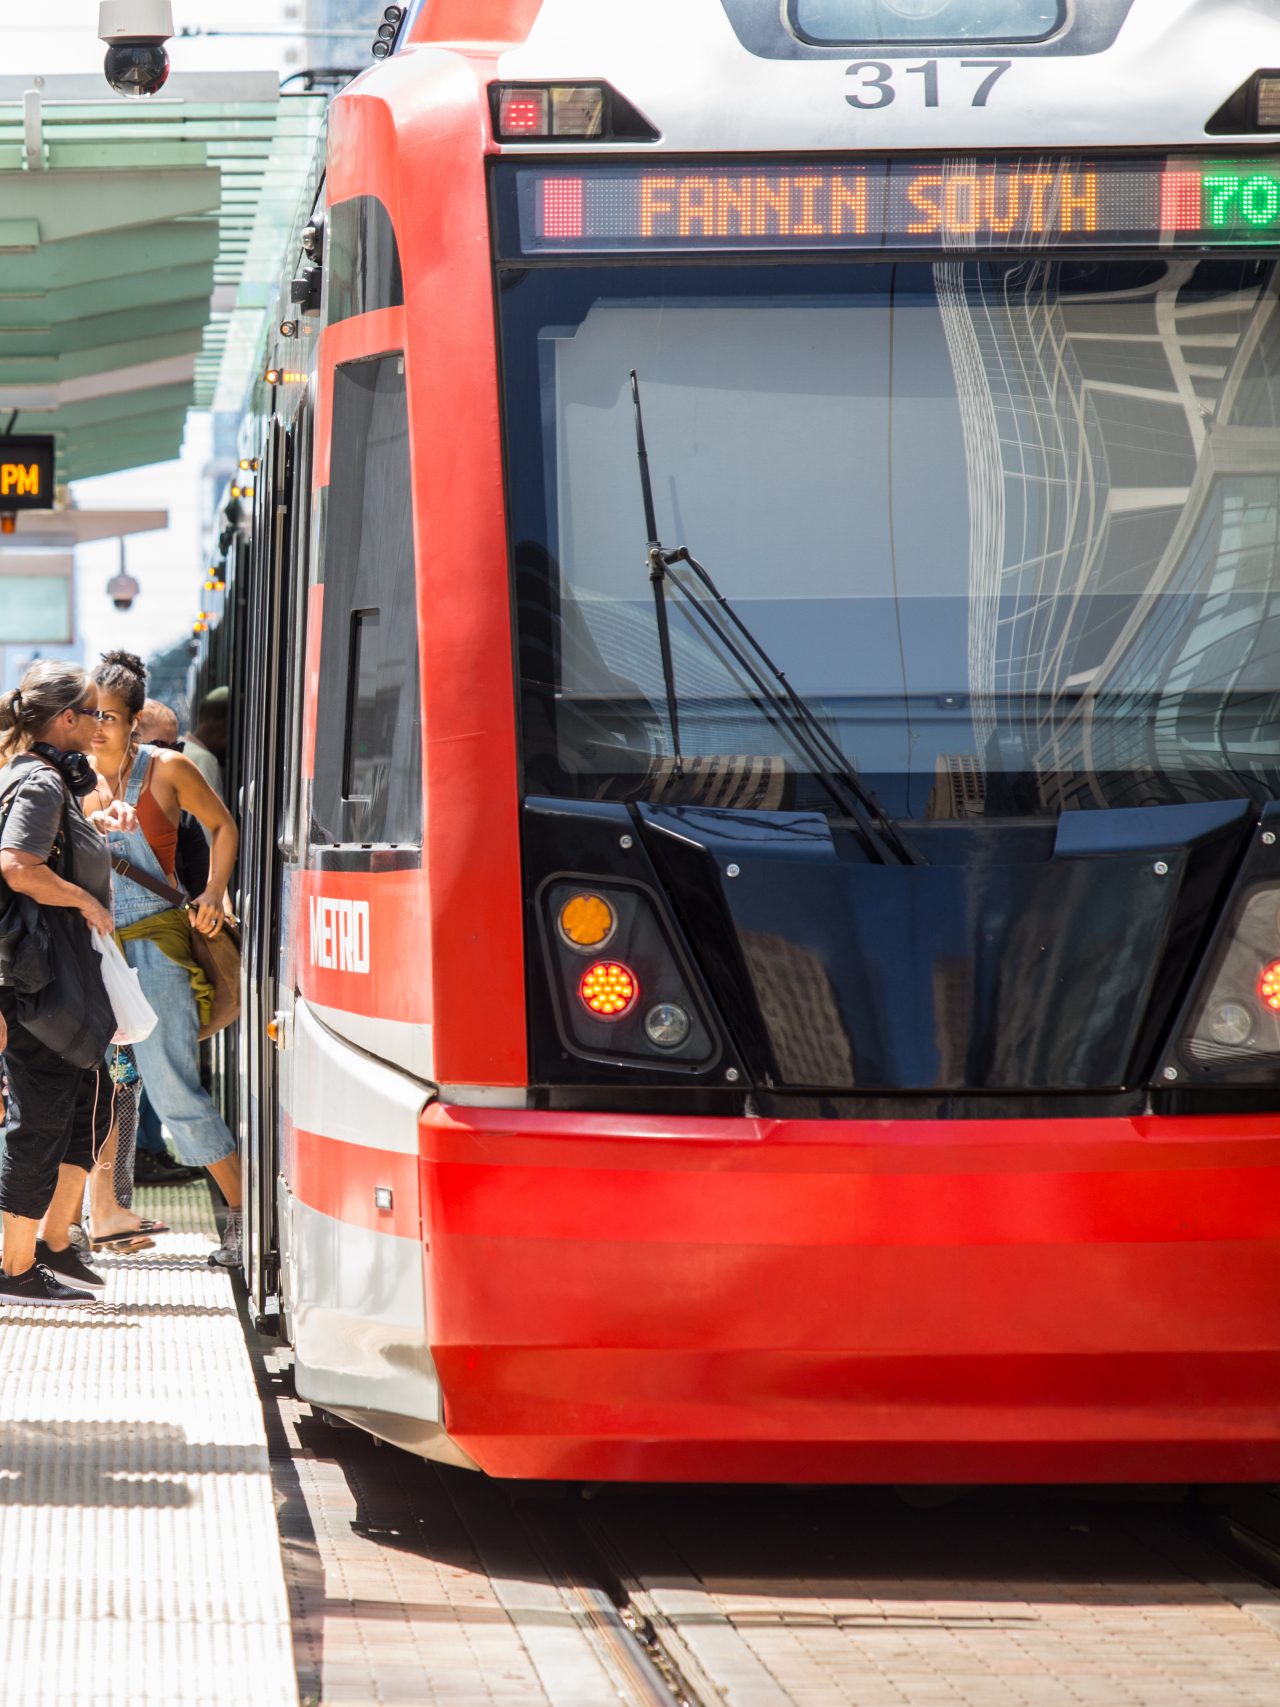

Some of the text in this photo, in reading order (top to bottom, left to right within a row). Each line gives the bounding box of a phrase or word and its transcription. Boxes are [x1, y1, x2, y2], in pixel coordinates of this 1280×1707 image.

[844, 59, 1013, 110] 317
[640, 172, 1098, 236] FANNIN SOUTH
[1203, 174, 1278, 225] 70
[0, 463, 39, 496] PM
[309, 895, 370, 974] METRO
